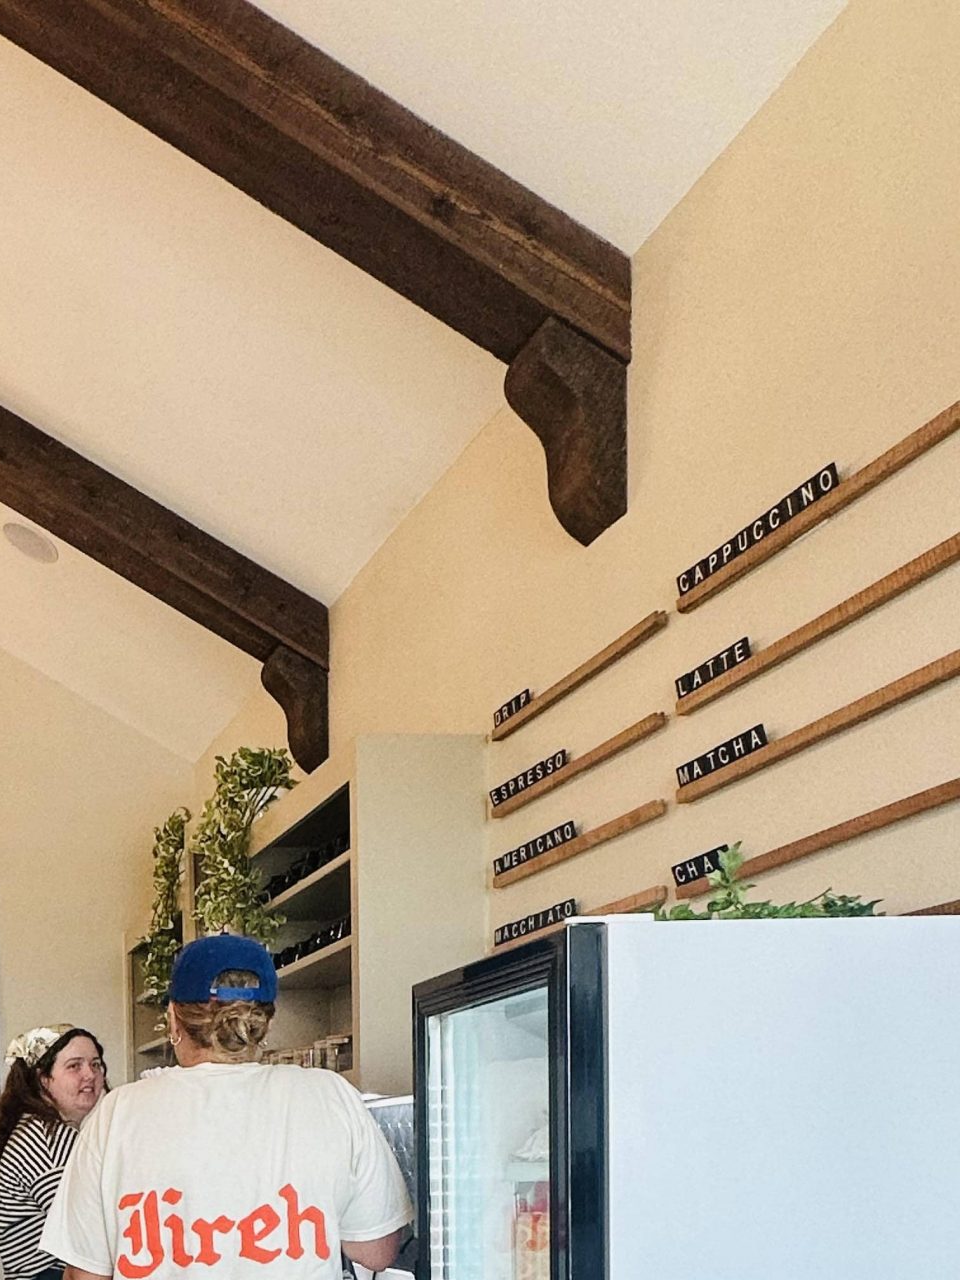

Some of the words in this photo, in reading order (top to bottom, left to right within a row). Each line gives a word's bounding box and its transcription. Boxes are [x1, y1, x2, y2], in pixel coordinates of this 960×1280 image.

[679, 469, 833, 592] CAPPUCCINO
[677, 642, 745, 696] LATTE
[495, 693, 527, 726] DRIP
[491, 753, 563, 804] ESPRESSO
[678, 730, 762, 785] MATCHA
[495, 824, 572, 874] AMERICANO
[674, 853, 720, 883] CHA
[495, 901, 573, 943] MACCHIATO
[117, 1183, 331, 1279] Jireh
